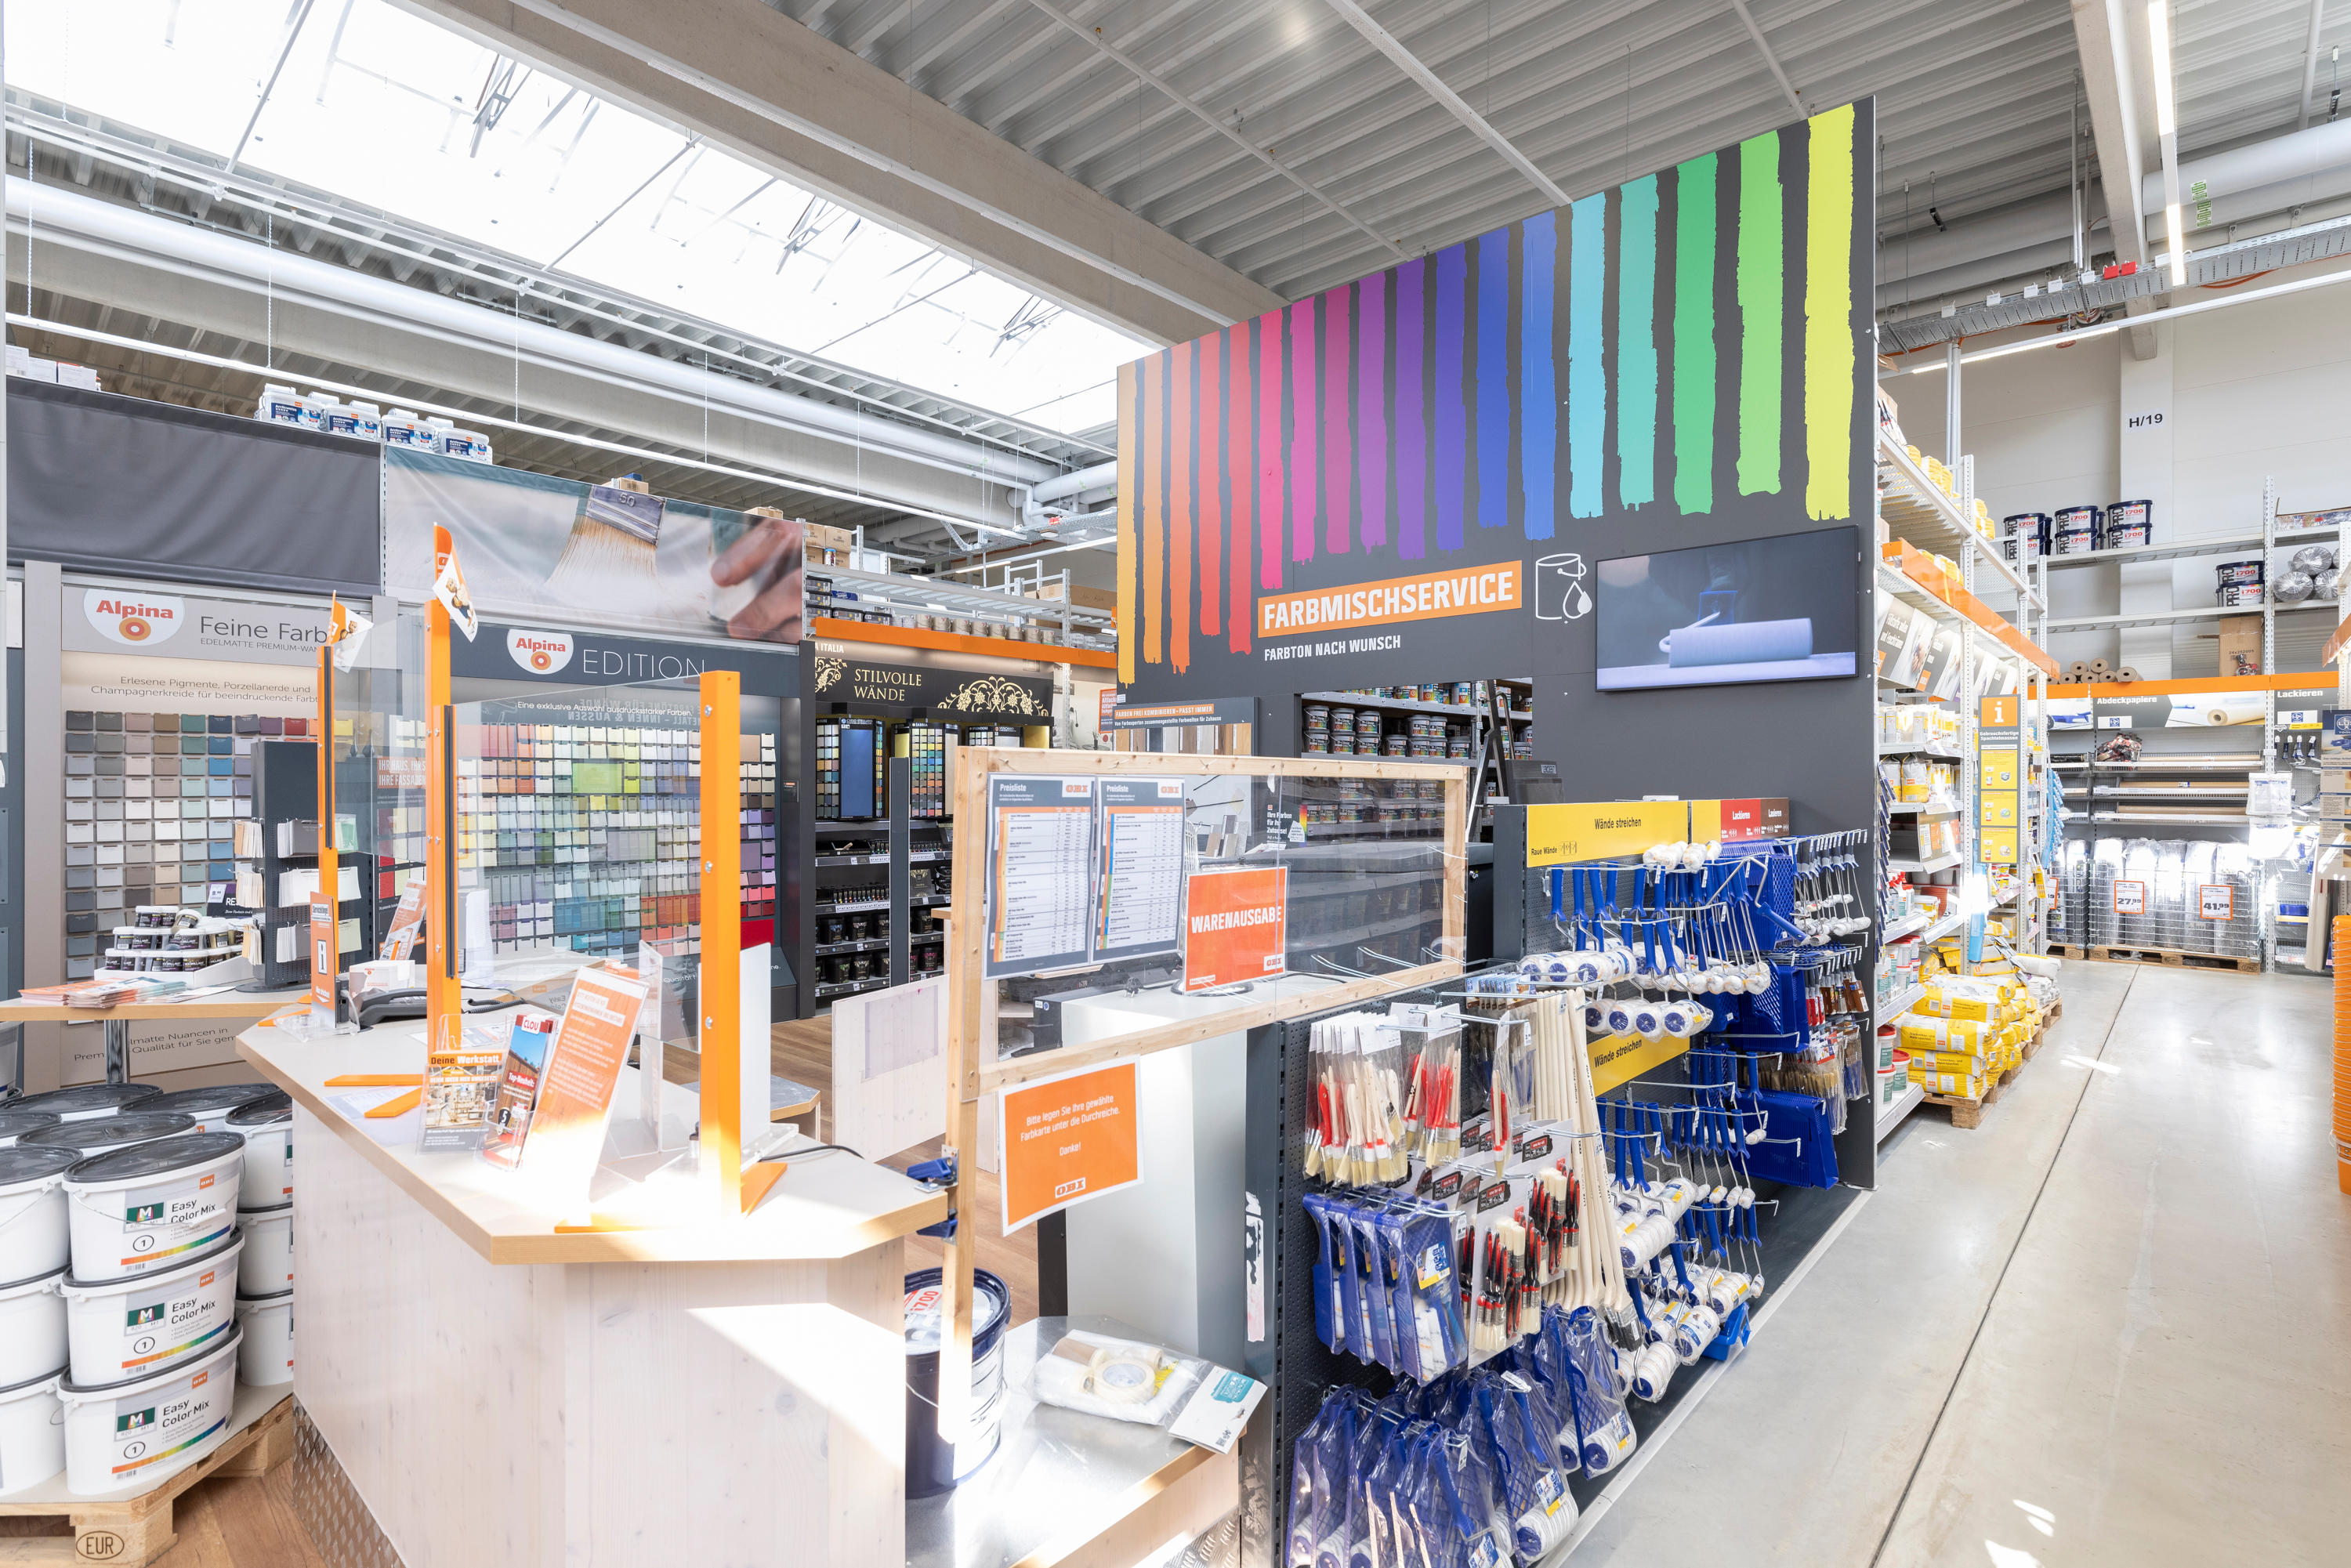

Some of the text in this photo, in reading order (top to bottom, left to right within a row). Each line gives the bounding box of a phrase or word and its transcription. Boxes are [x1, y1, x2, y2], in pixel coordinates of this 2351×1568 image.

[2128, 412, 2164, 429] H/19
[1264, 570, 1513, 630] FARBMISCHSERVICE
[2226, 586, 2240, 607] PRO
[96, 599, 173, 620] Alpina
[201, 615, 328, 644] Feine Farb
[201, 637, 319, 654] EDELMATTE PREMIUM-WAN
[516, 637, 567, 654] Alpina
[821, 643, 844, 654] ITALIA
[1264, 634, 1401, 662] FARBTON NACH WUNSCH
[583, 649, 705, 680] EDITION
[120, 675, 311, 693] Erlesene Pigmente, Porzellanerde und
[854, 668, 922, 687] STILVOLLE
[91, 685, 319, 704] Champagnerkreide für beeindruckende Farbt
[853, 684, 906, 702] WÄNDE
[2096, 694, 2157, 706] Abdeckpapiere
[2277, 690, 2324, 698] Lackieren
[517, 701, 694, 717] Eine exklusive Auswahl ausdrucksstarker Farben.
[1115, 708, 1133, 718] FARBEN
[1133, 708, 1143, 716] FREI
[1144, 708, 1176, 716] KOMBINIEREN
[1179, 706, 1194, 715] PASST
[379, 759, 390, 772] IHR
[379, 774, 394, 786] IHRE
[999, 784, 1089, 793] Preisliste OBI
[1107, 784, 1129, 793] Preisliste
[1594, 817, 1642, 830] Wände streichen
[1544, 846, 1558, 855] Wände
[226, 897, 237, 906] RE
[2117, 897, 2142, 906] 27,99
[2203, 902, 2230, 911] 41,99
[1190, 905, 1283, 935] WARENAUSGABE
[523, 1020, 539, 1031] CLOU
[129, 1034, 165, 1046] lmatte
[168, 1029, 216, 1041] Nuancen
[74, 1034, 237, 1062] Prem Qualität für Sie gem
[1594, 1038, 1643, 1067] Wände streichen
[431, 1056, 455, 1065] Deine
[1026, 1095, 1114, 1127] Bitte legen Sie Ihre gewählte
[1020, 1106, 1121, 1142] Farbkarte unter die Durchreiche.
[1059, 1141, 1081, 1157] Danke!
[1056, 1179, 1085, 1197] OBI
[139, 1206, 153, 1220] M
[171, 1204, 216, 1223] Color Mix
[172, 1199, 197, 1212] Easy
[172, 1298, 197, 1313] Easy
[909, 1291, 940, 1311] i700
[140, 1308, 154, 1321] M
[171, 1300, 216, 1324] Color Mix
[162, 1400, 210, 1428] Color Mix
[163, 1400, 190, 1416] Easy
[129, 1412, 143, 1426] M
[85, 1534, 114, 1556] EUR
